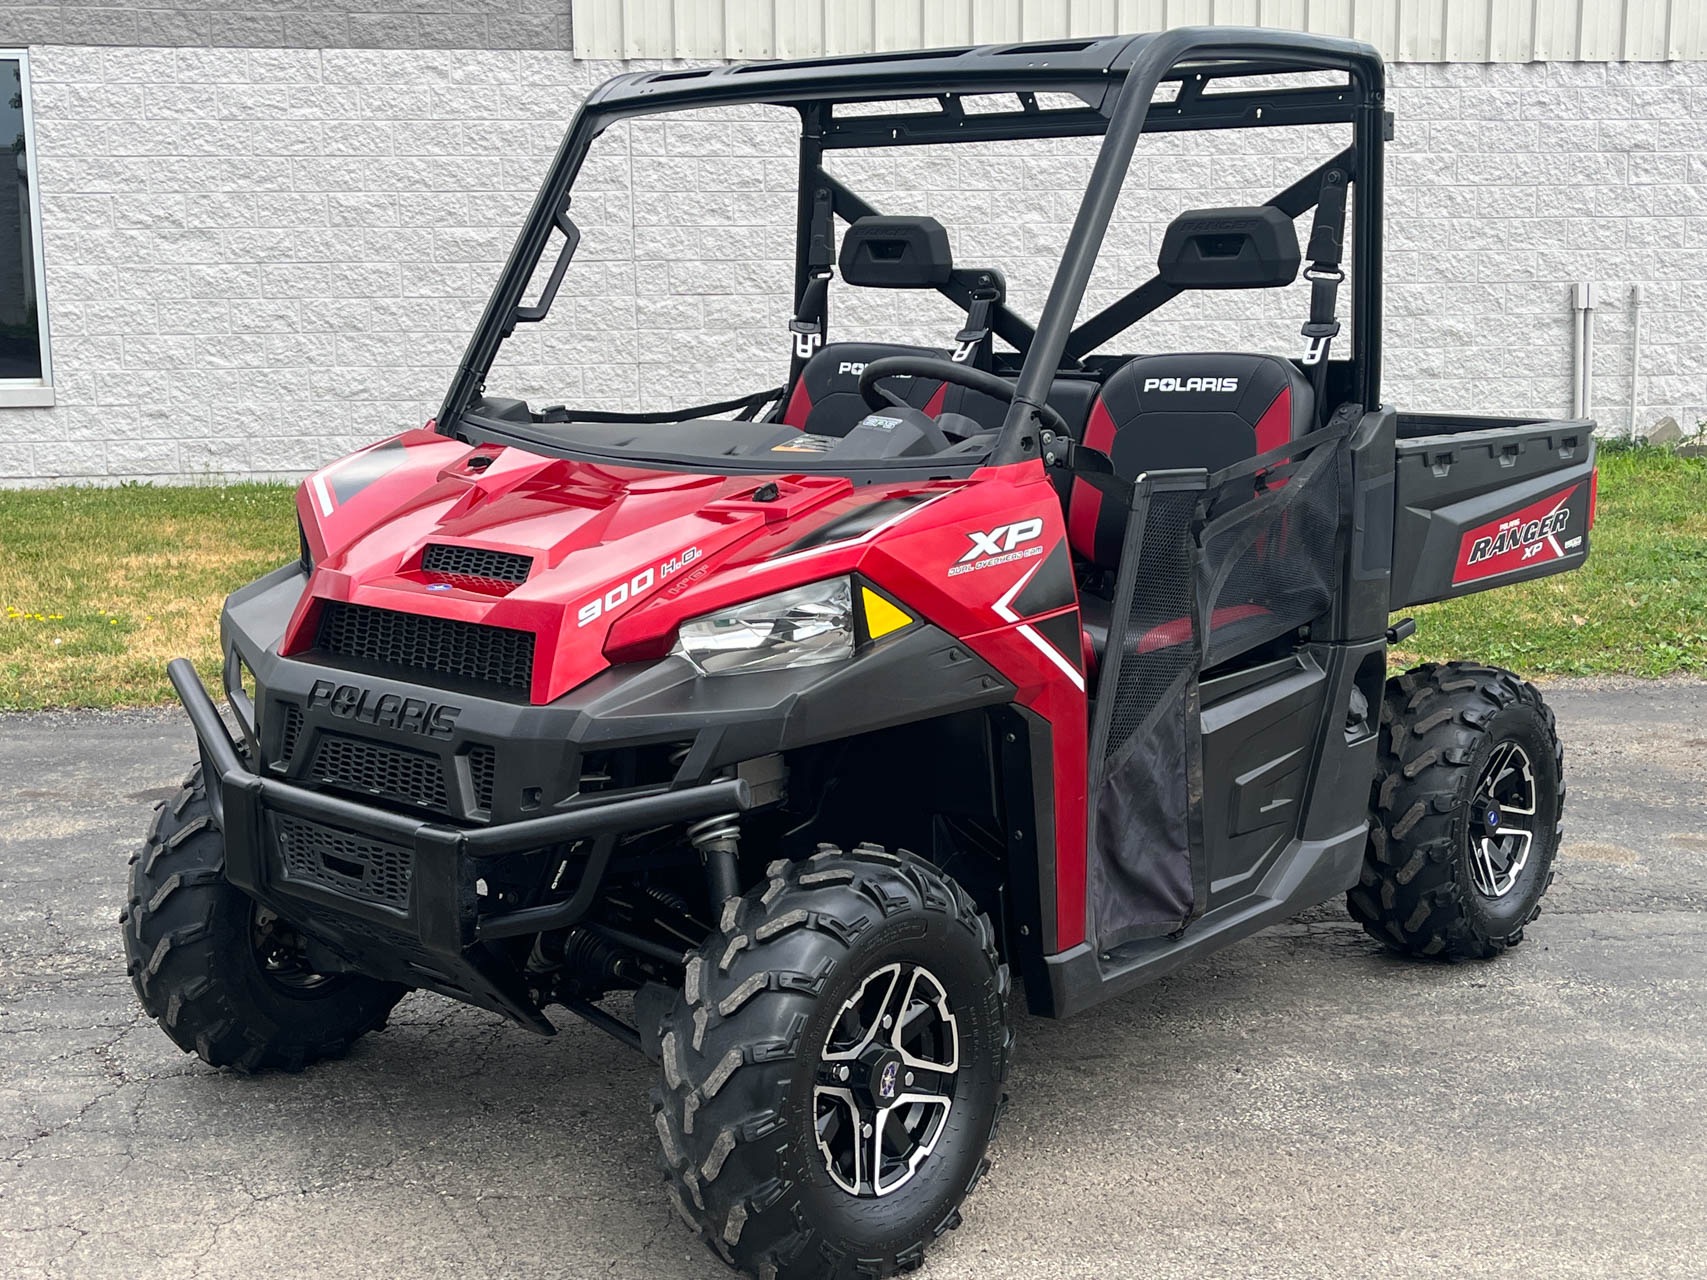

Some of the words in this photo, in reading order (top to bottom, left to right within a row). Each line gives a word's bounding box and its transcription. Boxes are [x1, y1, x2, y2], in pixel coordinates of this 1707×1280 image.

[1143, 377, 1239, 392] POLARIS
[957, 516, 1044, 563] XP
[1467, 508, 1570, 565] RANGER
[1521, 542, 1544, 560] XP
[577, 567, 654, 628] 900
[660, 546, 702, 579] H.O.
[947, 563, 975, 577] DUAL
[307, 679, 462, 742] POLARIS
